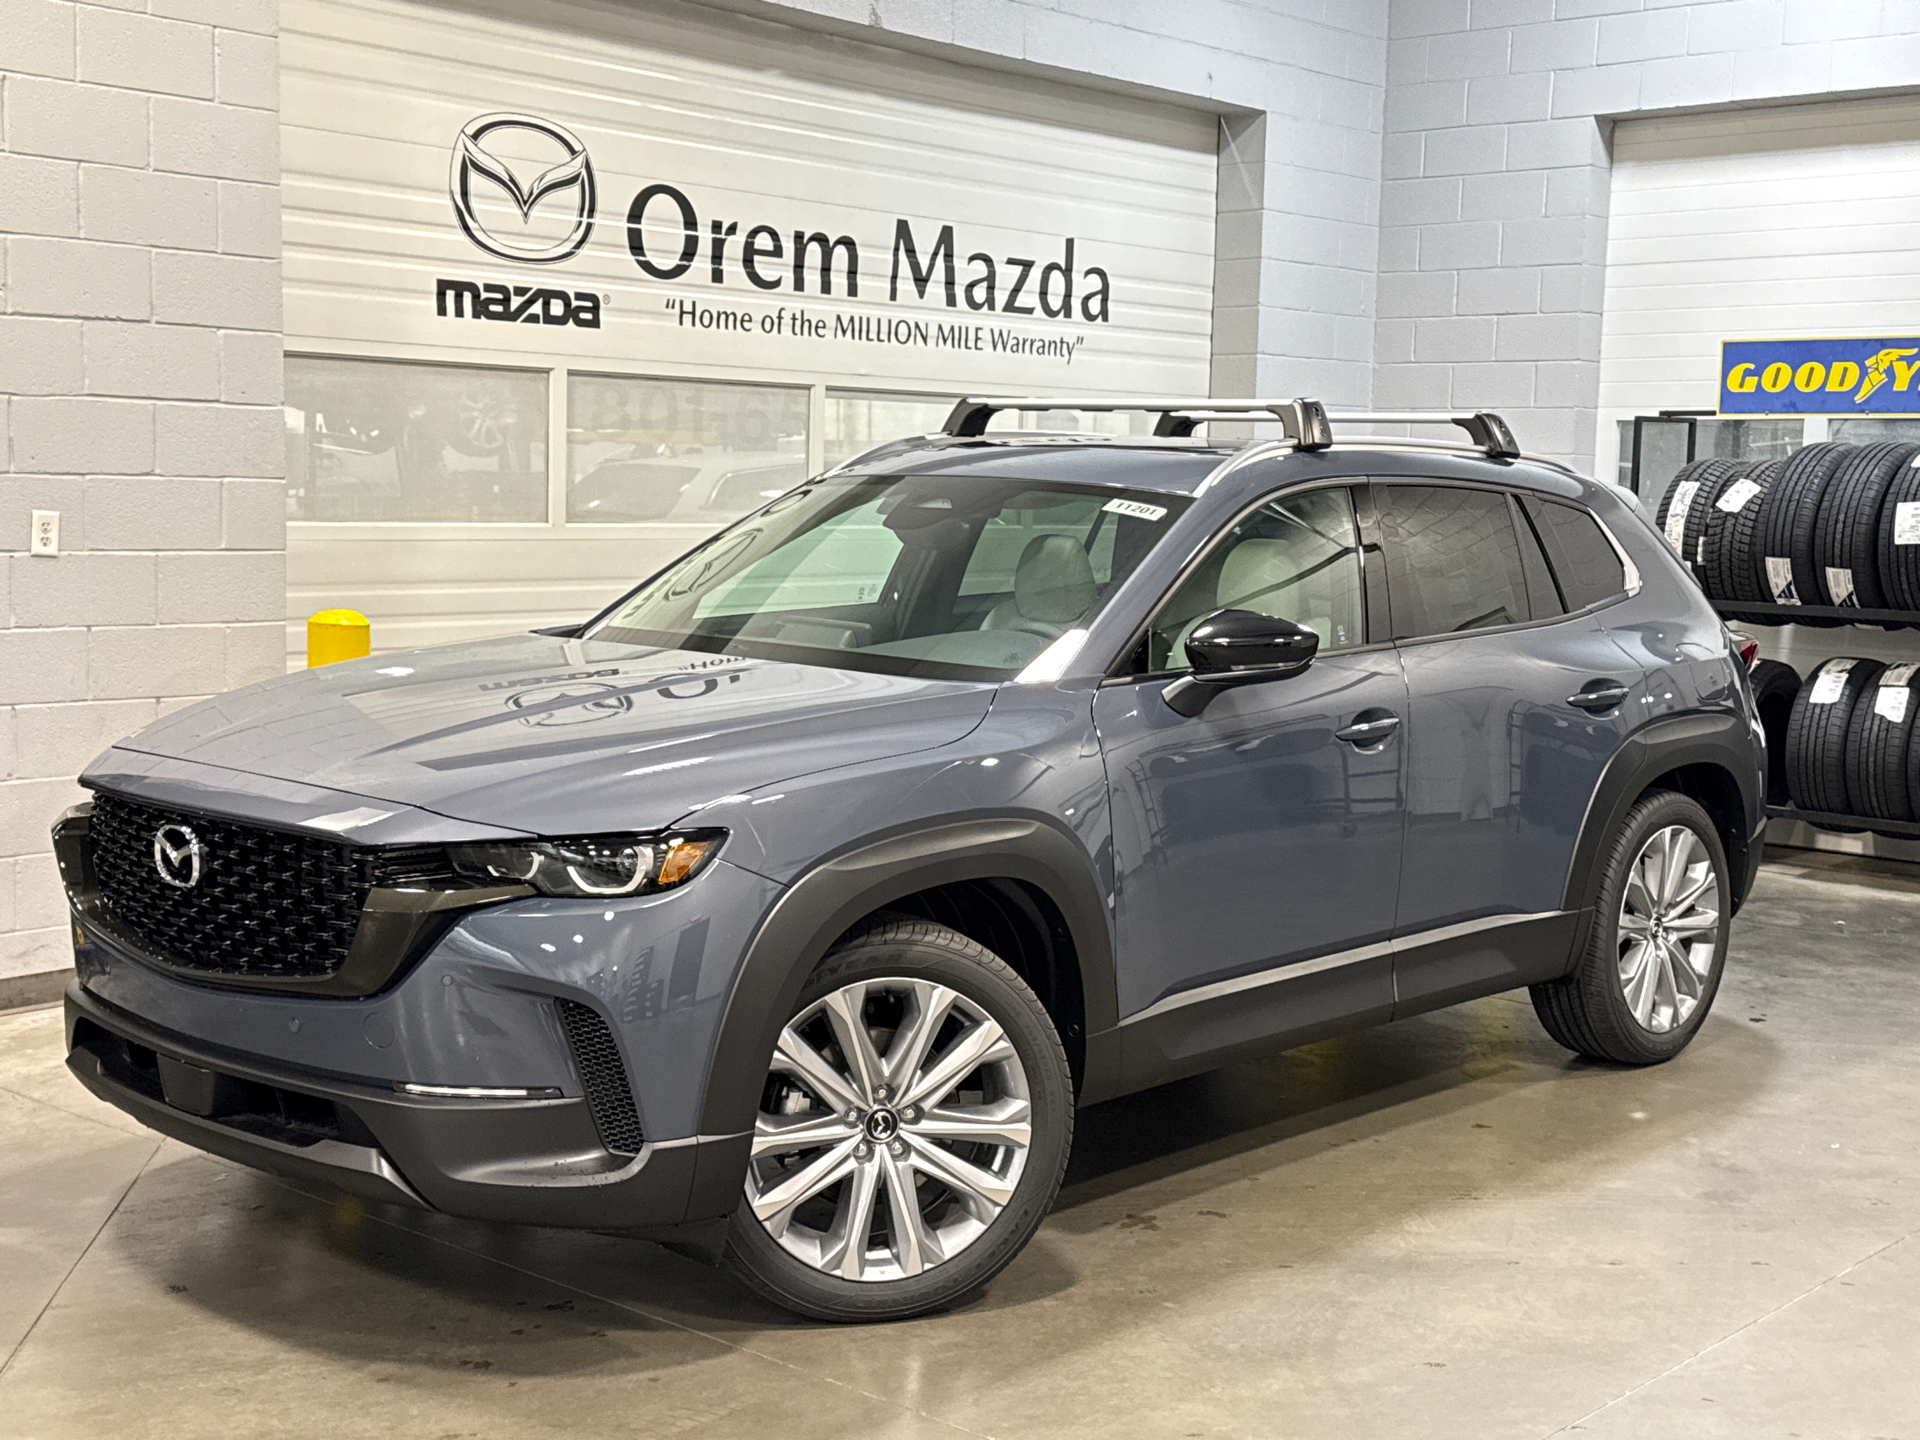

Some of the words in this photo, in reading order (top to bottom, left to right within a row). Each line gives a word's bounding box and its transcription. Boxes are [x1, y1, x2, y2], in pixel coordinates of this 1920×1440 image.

[626, 183, 859, 298] Orem
[888, 217, 1111, 323] Mazda
[761, 307, 786, 335] of
[791, 309, 827, 338] the
[834, 313, 929, 347] MILLION
[935, 323, 984, 351] MILE
[1726, 360, 1920, 394] GOODY
[1115, 501, 1158, 516] 11201
